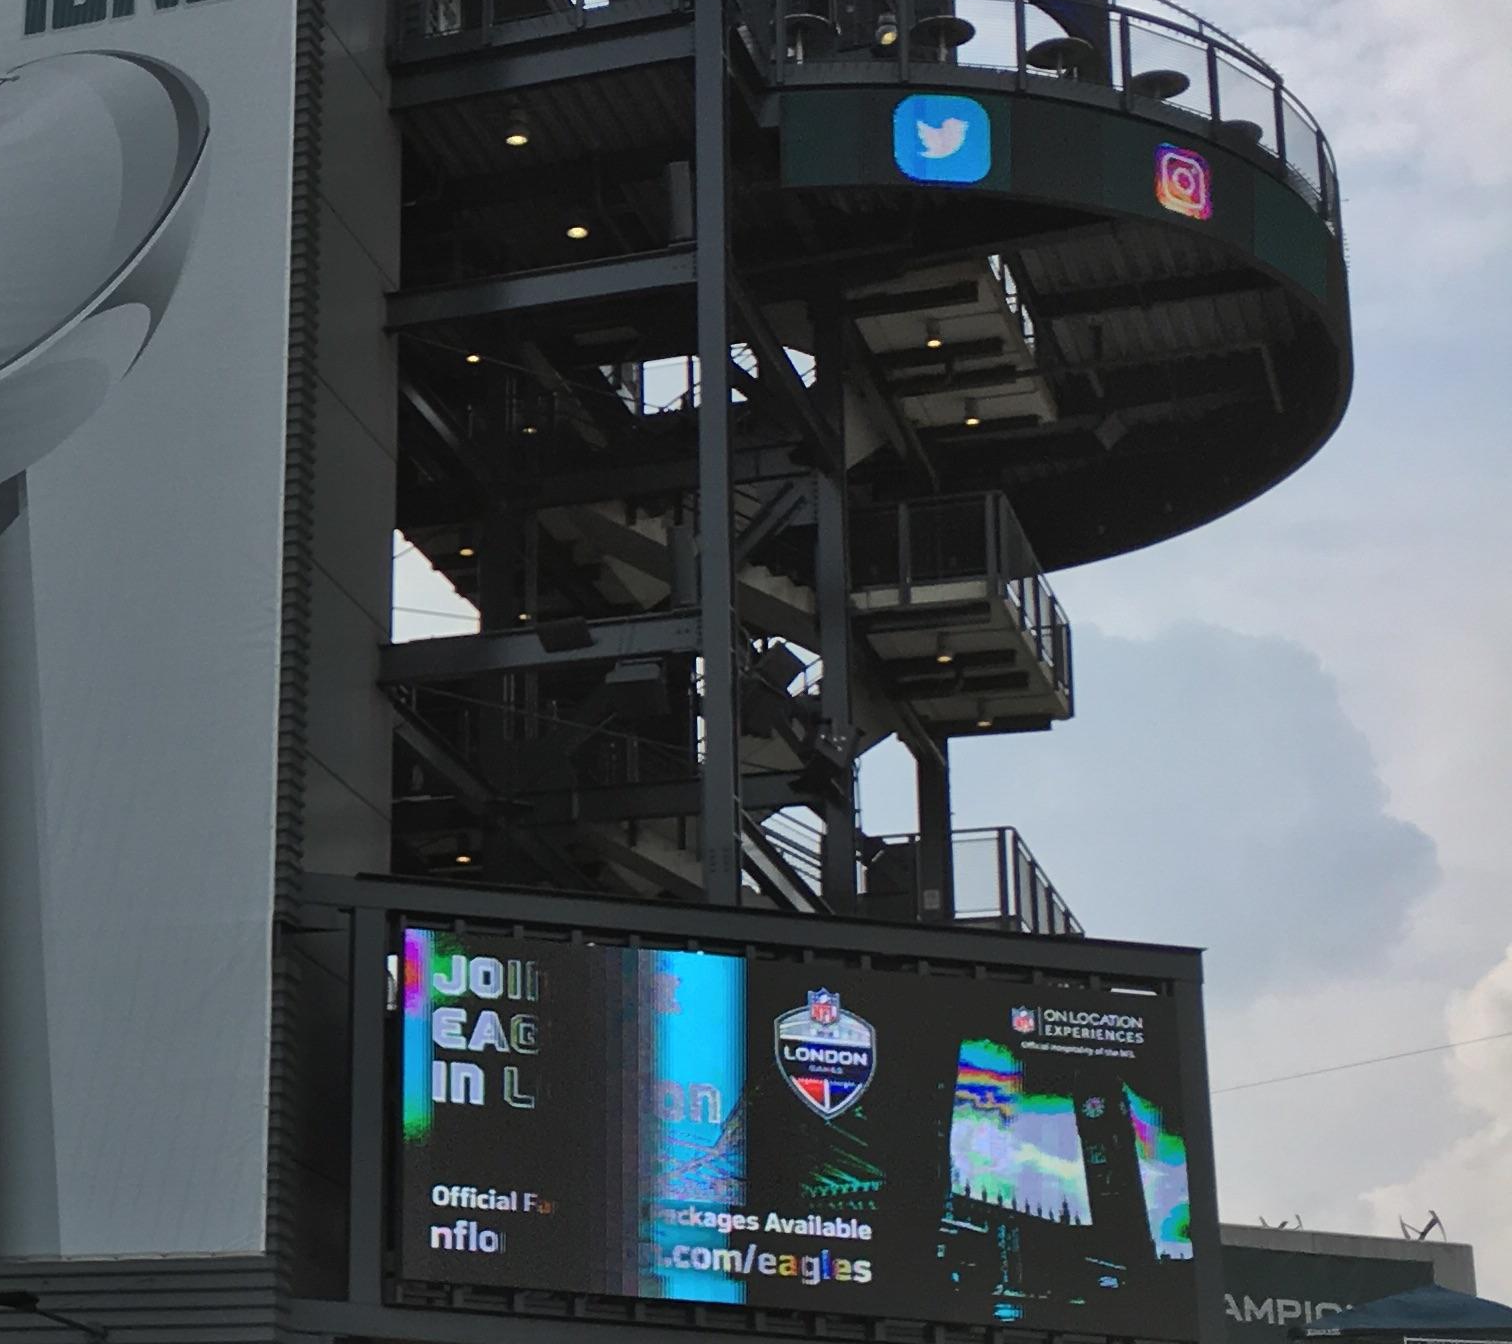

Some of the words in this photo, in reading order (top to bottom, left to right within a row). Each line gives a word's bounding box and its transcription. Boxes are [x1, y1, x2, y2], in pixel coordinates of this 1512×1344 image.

[1044, 1023, 1145, 1045] EXPERIENCES
[783, 1044, 868, 1067] LONDON
[431, 1184, 518, 1211] Official
[764, 1212, 873, 1241] Available
